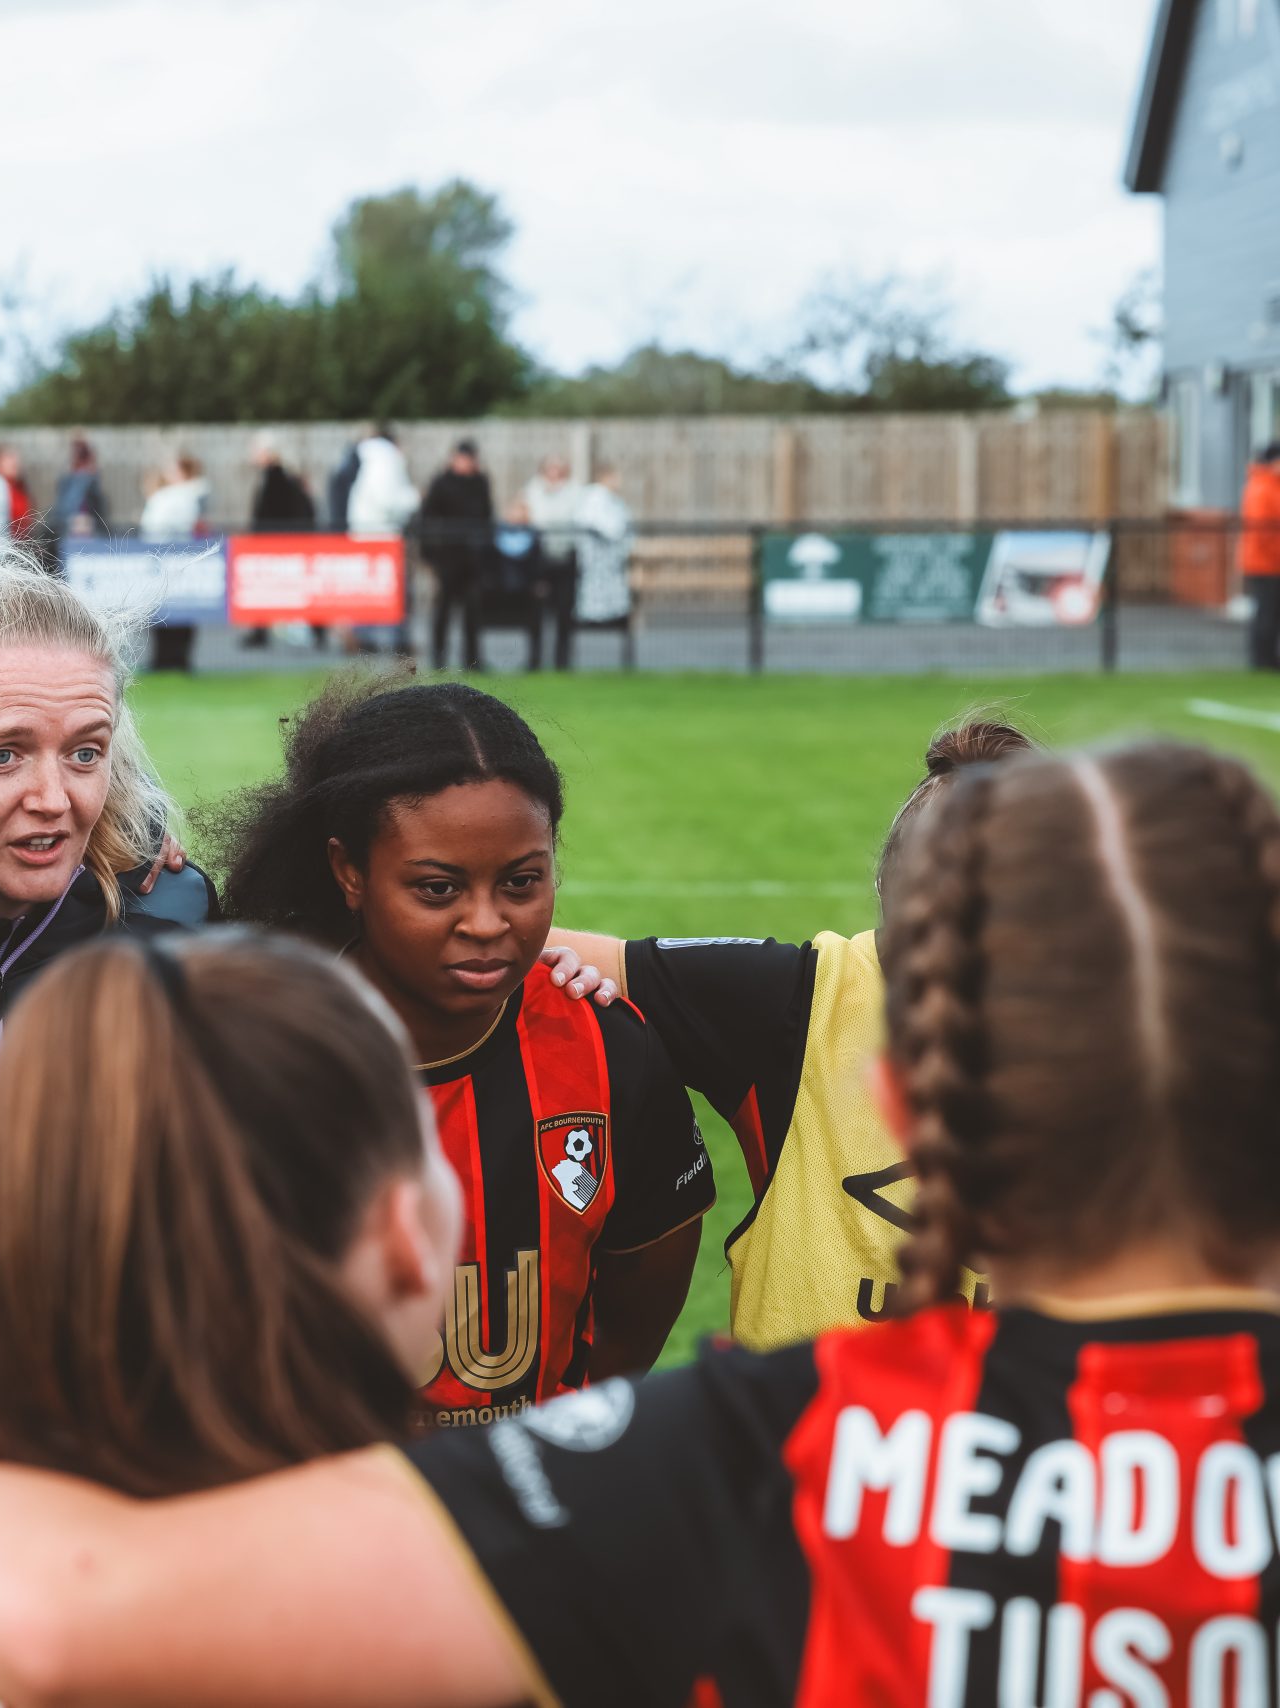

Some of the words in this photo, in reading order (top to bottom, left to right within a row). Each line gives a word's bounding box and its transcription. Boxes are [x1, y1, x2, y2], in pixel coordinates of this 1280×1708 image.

[540, 1122, 553, 1131] AFC
[554, 1117, 604, 1127] BOURNEMOUTH
[676, 1152, 707, 1190] Field
[416, 1250, 539, 1390] U
[823, 1404, 1280, 1580] MEADO
[910, 1584, 1280, 1708] TUSO
